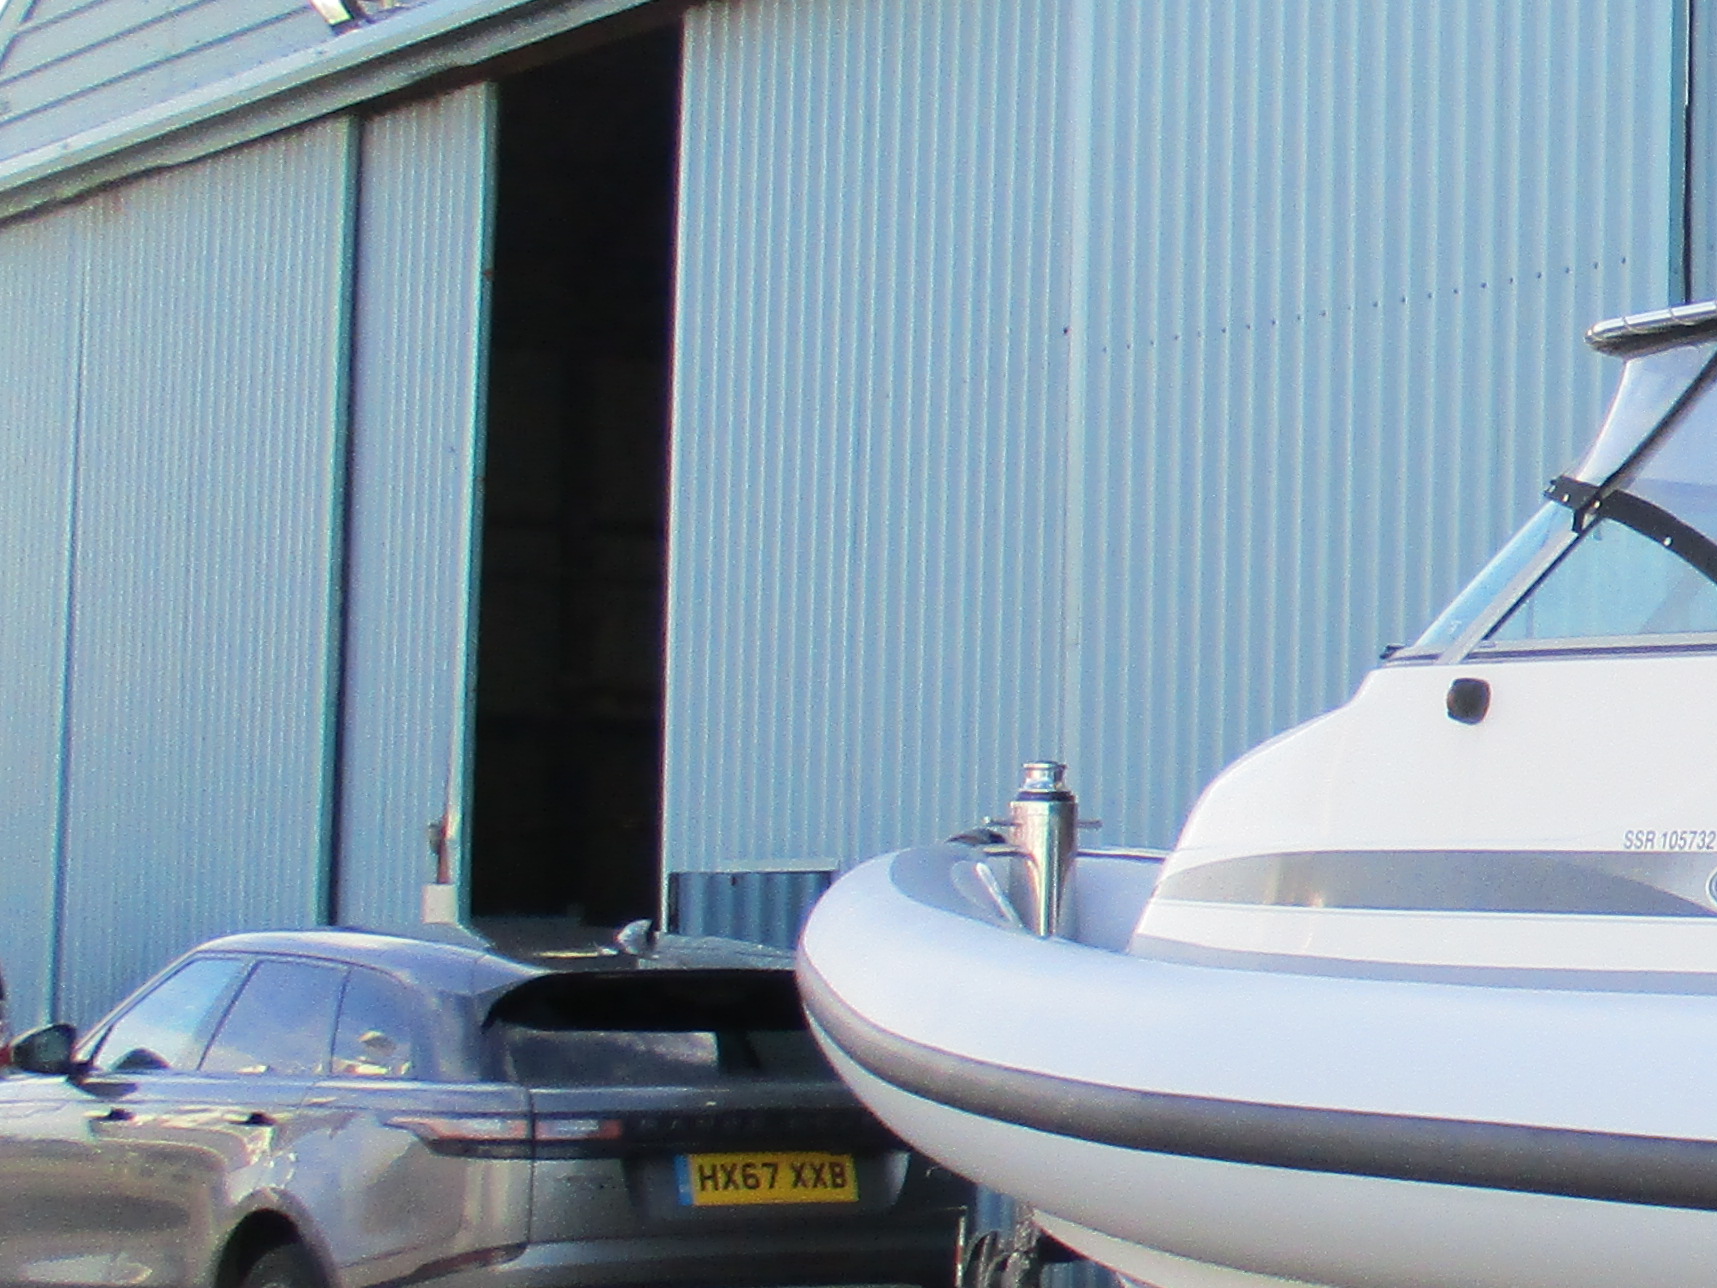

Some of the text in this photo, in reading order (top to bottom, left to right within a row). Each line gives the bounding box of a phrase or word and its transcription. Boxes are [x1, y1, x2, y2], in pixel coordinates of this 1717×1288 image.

[1624, 830, 1717, 851] SSR 105732
[700, 1161, 848, 1192] HX67 XXB
